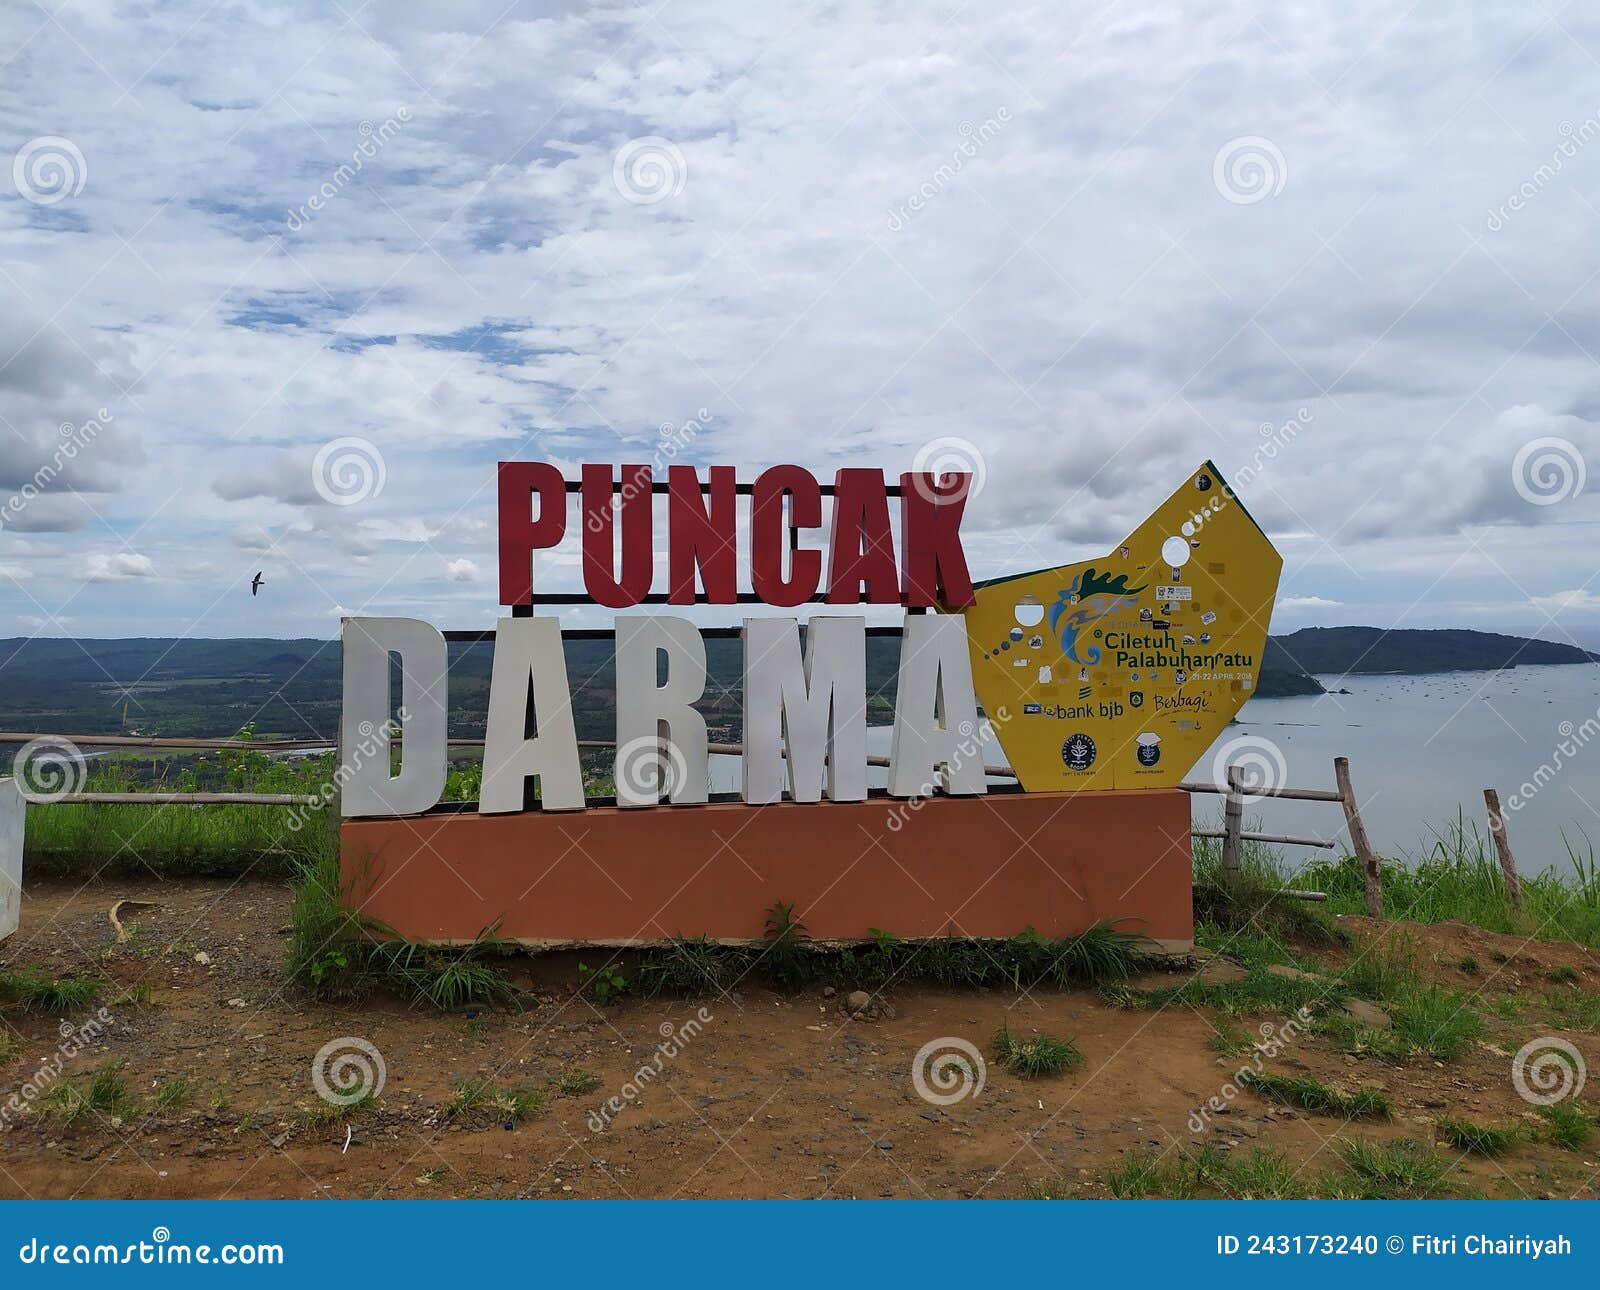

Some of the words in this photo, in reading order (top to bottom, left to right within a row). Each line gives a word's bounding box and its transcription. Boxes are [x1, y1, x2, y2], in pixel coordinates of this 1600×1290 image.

[498, 461, 977, 608] PUNCAK
[1104, 631, 1178, 652] Ciletuh
[1116, 648, 1253, 671] Palabuhanratu
[340, 614, 988, 816] DARMA
[1057, 703, 1095, 719] bank
[1099, 702, 1124, 720] bjb
